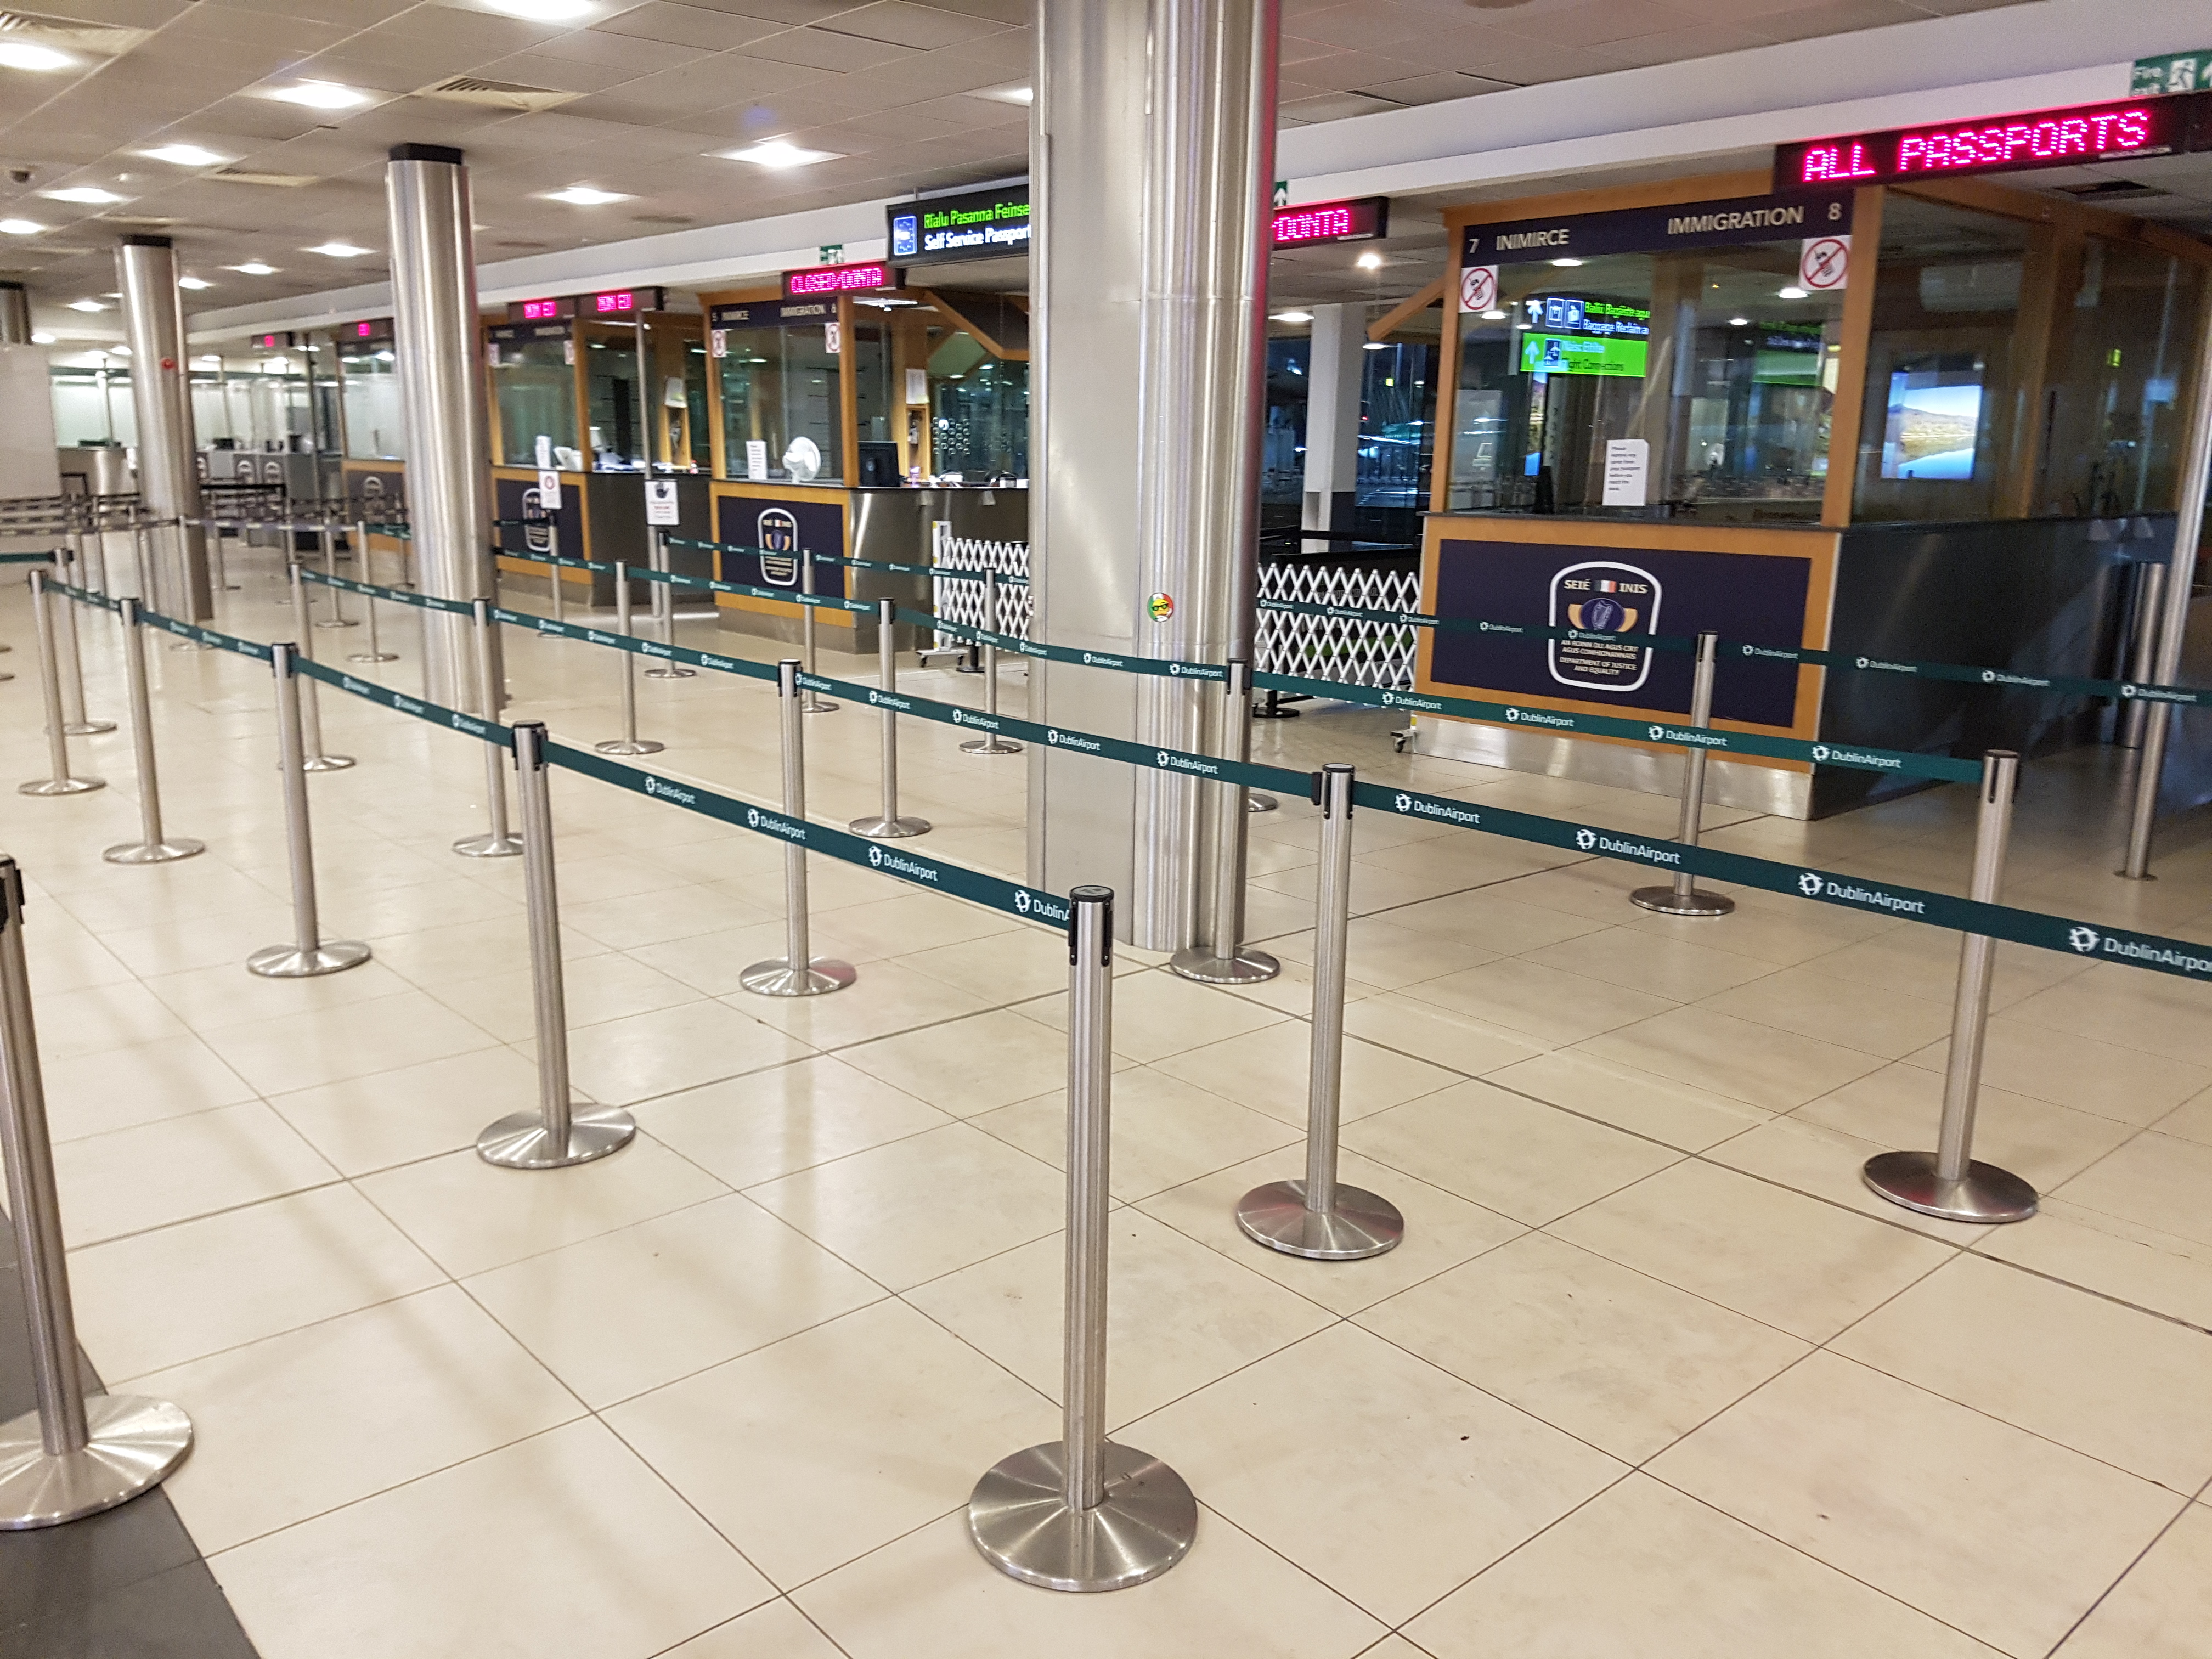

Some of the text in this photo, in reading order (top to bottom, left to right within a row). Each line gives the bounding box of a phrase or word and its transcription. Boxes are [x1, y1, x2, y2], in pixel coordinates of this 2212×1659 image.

[1803, 110, 2148, 182] ALL PASSPORTS
[1667, 202, 1842, 235] IMMIGRATION 8
[924, 232, 945, 250] Self
[945, 230, 984, 247] Service
[1469, 229, 1570, 253] 7 INIMIRCE
[1619, 583, 1648, 594] INIS
[1181, 667, 1223, 678] DublinAirport
[1869, 661, 1917, 672] DublinAirport
[1996, 674, 2051, 686] DublinAirport
[1396, 695, 1442, 710] DublinAirport
[2138, 687, 2197, 702] DublinAirport
[963, 714, 1000, 730] DublinAirport
[1520, 712, 1574, 727] DublinAirport
[1059, 733, 1101, 751] DublinAirport
[1666, 729, 1728, 747] DublinAirport
[1170, 756, 1218, 774] DublinAirport
[1832, 749, 1901, 769] DublinAirport
[1414, 800, 1481, 823] DublinAirport
[760, 815, 806, 840] DublinAirport
[1599, 836, 1681, 865] DublinAirport
[884, 853, 938, 882] DublinAirport
[1827, 881, 1925, 915] DublinAirport
